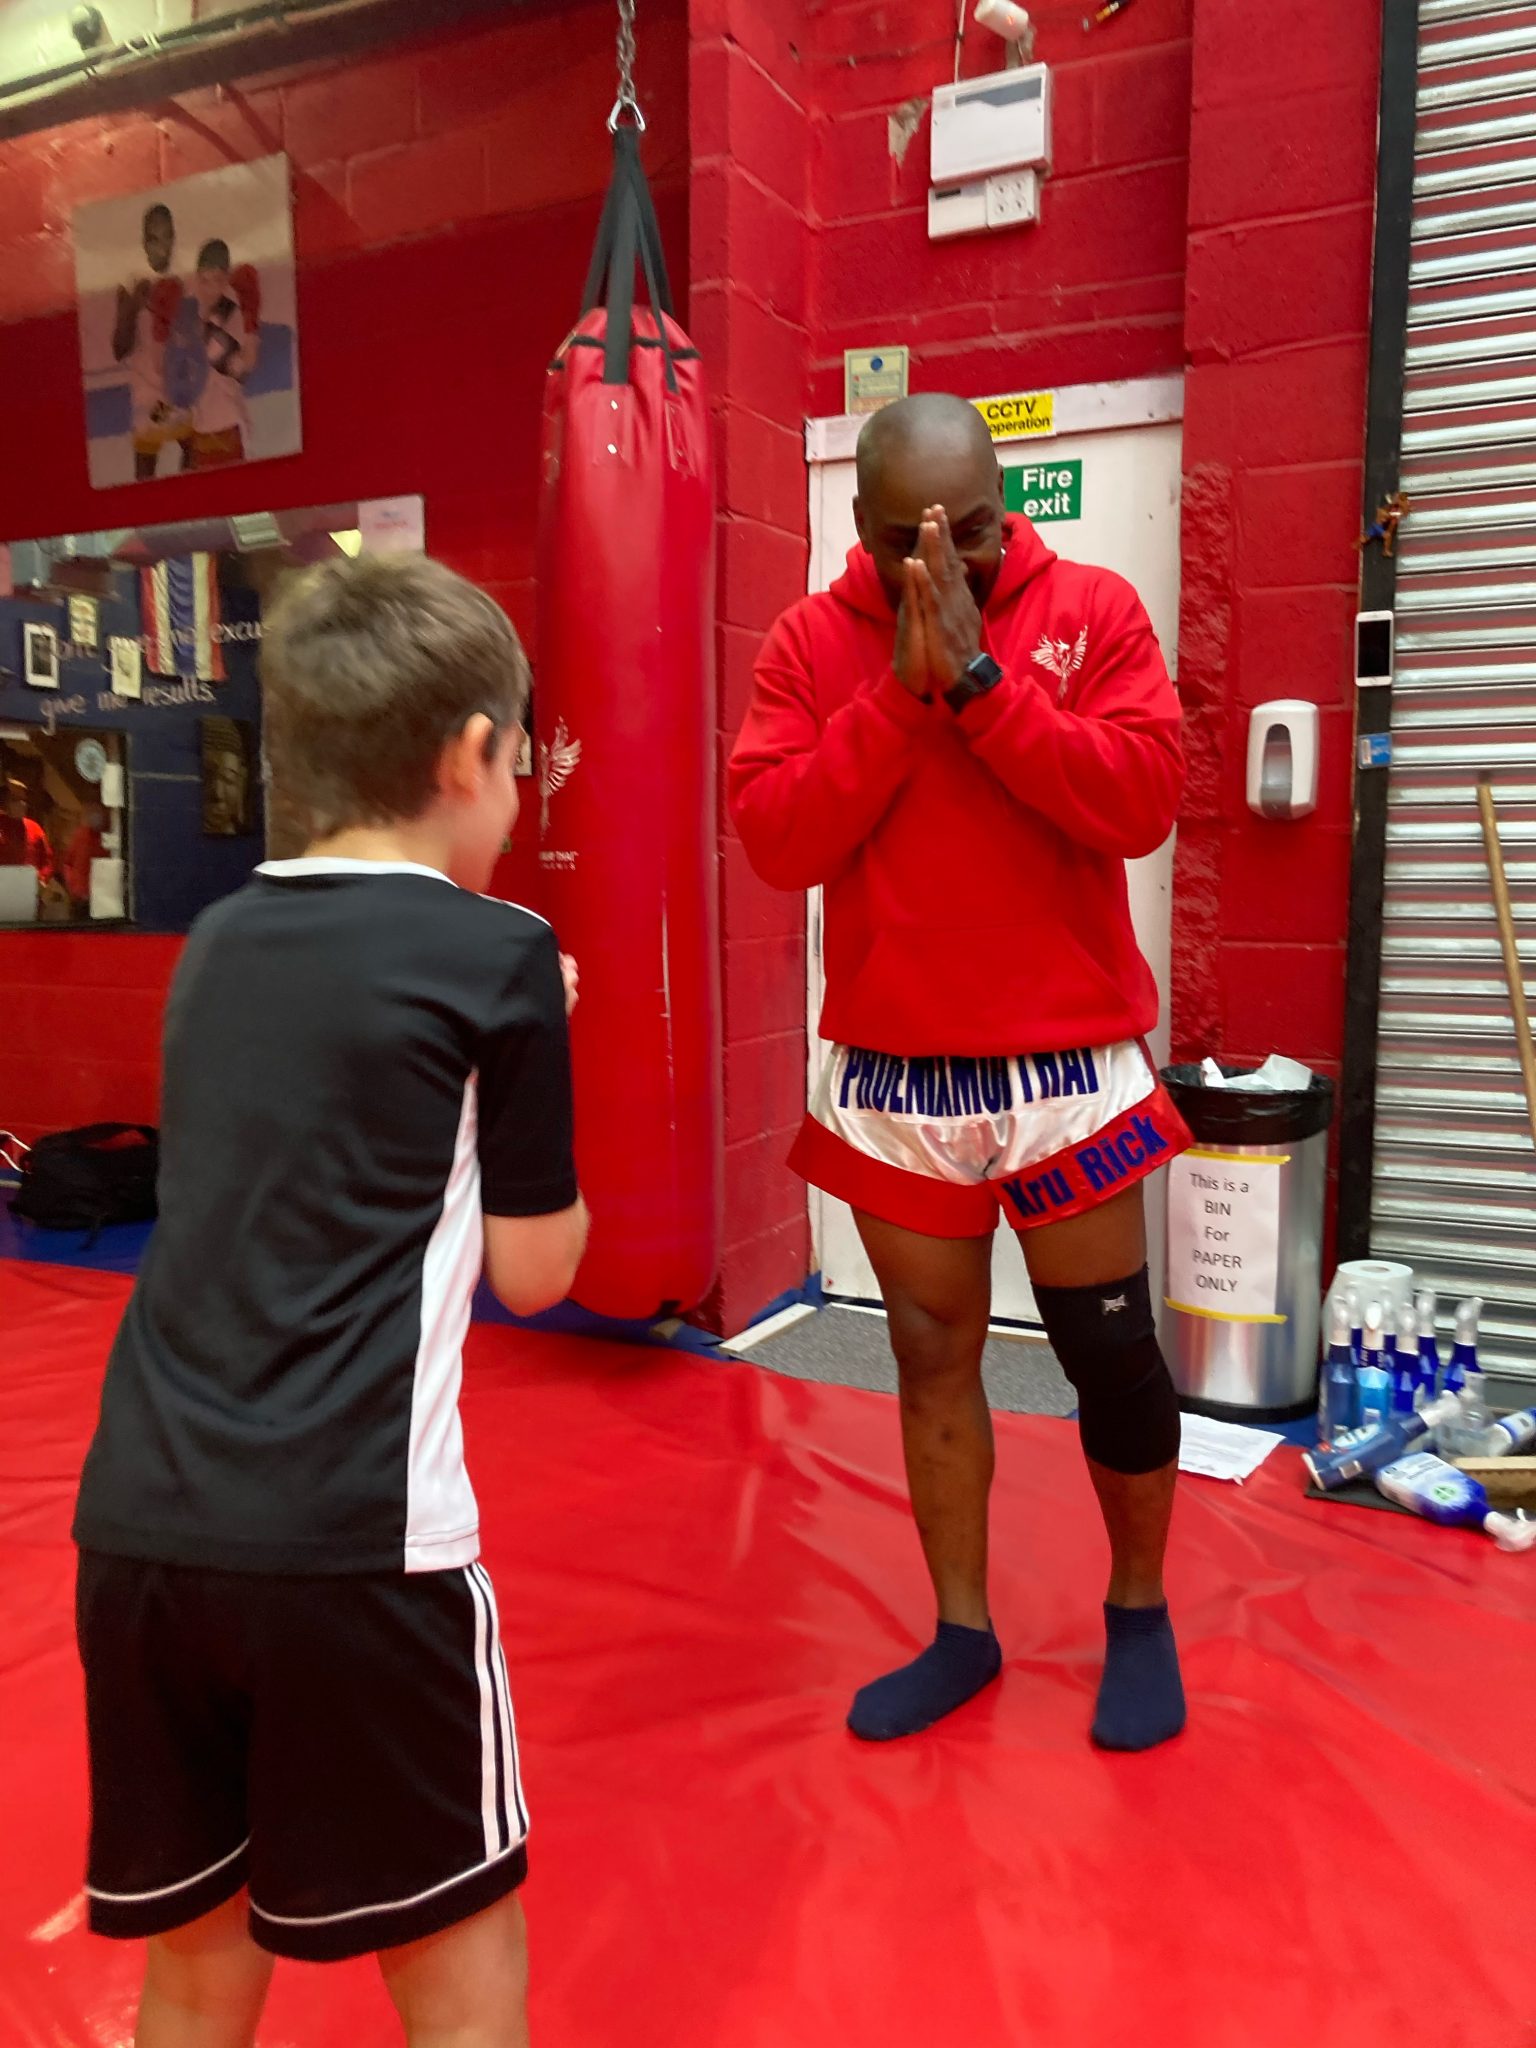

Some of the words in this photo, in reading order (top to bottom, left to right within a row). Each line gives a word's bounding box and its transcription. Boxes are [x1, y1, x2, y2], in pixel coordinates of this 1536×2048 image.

[987, 399, 1037, 420] CCTV
[989, 416, 1051, 436] operation
[1022, 467, 1074, 492] Fire
[1023, 492, 1072, 518] exit
[1002, 1167, 1077, 1218] Kru
[1074, 1114, 1169, 1192] Rick
[1189, 1172, 1219, 1191] This
[1223, 1177, 1236, 1192] is
[1239, 1182, 1250, 1193] a
[1204, 1199, 1232, 1216] BIN
[1204, 1225, 1230, 1241] For
[1191, 1248, 1243, 1269] PAPER
[1195, 1274, 1239, 1292] ONLY
